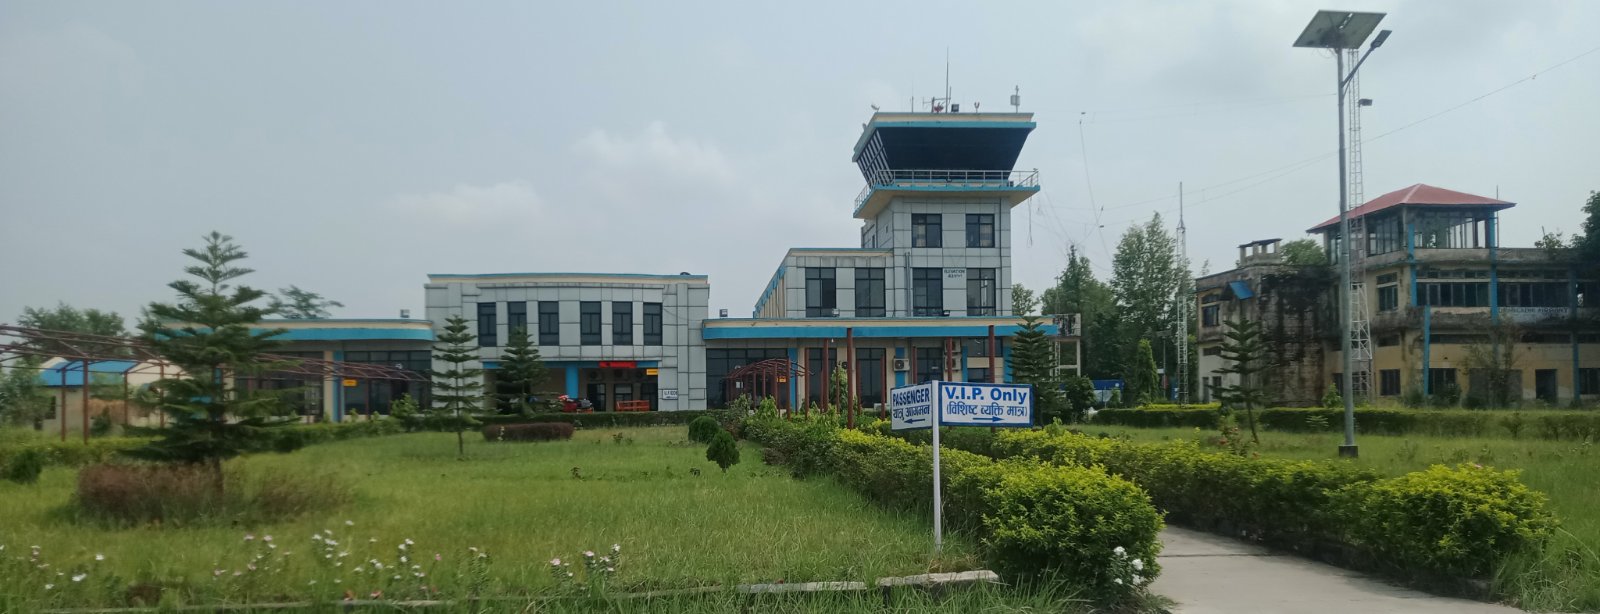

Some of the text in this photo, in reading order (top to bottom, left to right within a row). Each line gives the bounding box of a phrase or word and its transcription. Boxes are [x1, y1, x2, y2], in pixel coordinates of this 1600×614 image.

[893, 387, 930, 406] PASSENGER
[945, 386, 1027, 404] V.I.P. Only
